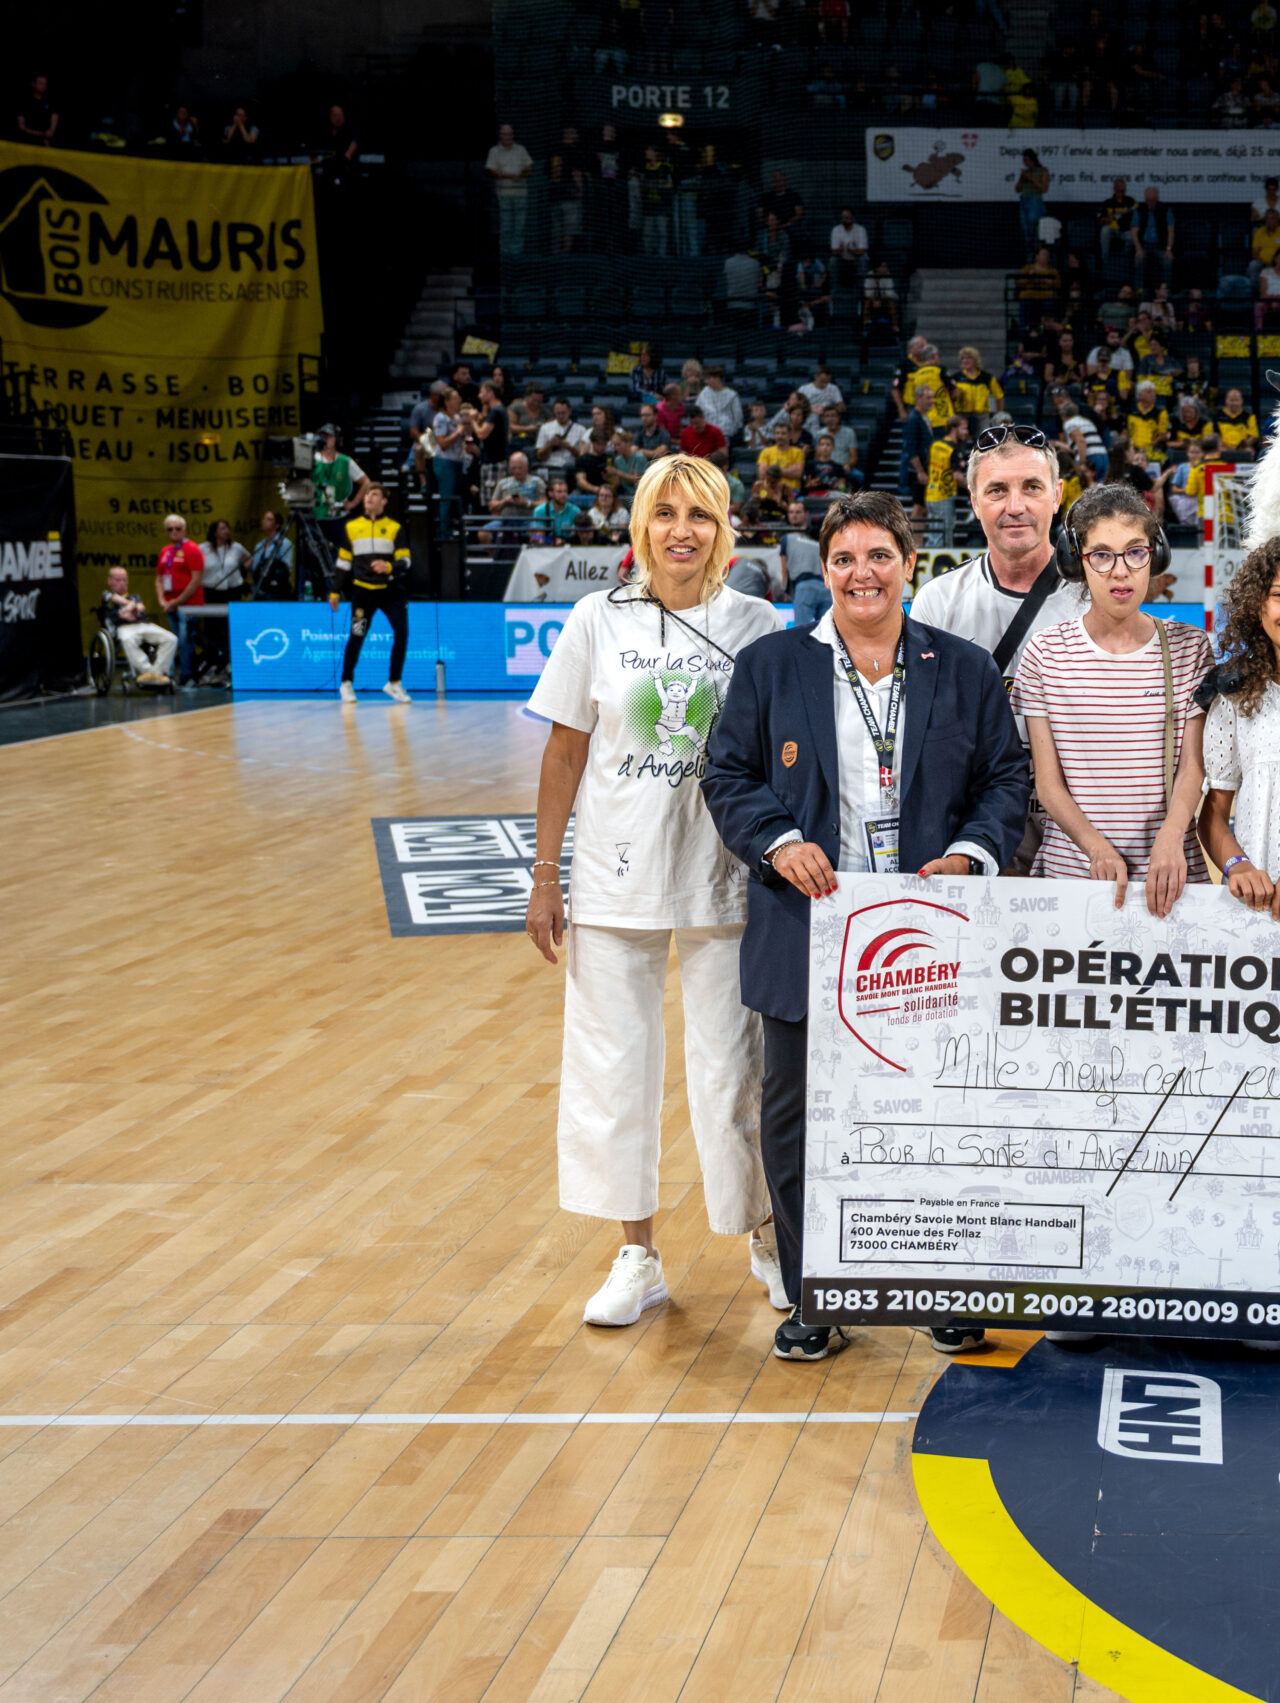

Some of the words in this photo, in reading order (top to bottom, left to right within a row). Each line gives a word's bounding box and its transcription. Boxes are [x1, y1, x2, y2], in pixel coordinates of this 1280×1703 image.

[611, 85, 692, 109] PORTE
[703, 85, 730, 109] 12
[1096, 146, 1109, 157] de
[1112, 146, 1162, 157] rassembler
[1166, 147, 1188, 157] nous
[1251, 147, 1264, 157] 25
[1150, 173, 1188, 185] toujours
[1207, 173, 1246, 183] continue
[46, 207, 83, 295] BOIS
[88, 211, 306, 273] MAURIS
[229, 373, 295, 396] BOIS
[109, 498, 119, 514] 9
[129, 498, 213, 515] AGENCES
[565, 559, 609, 581] Allez
[619, 649, 662, 670] Pour
[665, 651, 684, 671] la
[892, 681, 901, 702] TEAM
[867, 717, 880, 738] TEAM
[899, 874, 944, 894] JAUNE
[946, 885, 966, 899] ET
[934, 902, 970, 918] NOIR
[1009, 896, 1060, 913] SAVOIE
[855, 959, 962, 993] CHAMBÉRY
[855, 991, 879, 1002] SAVOIE
[881, 988, 900, 999] MONT
[901, 986, 923, 997] BLANC
[924, 981, 959, 993] HANDBALL
[903, 990, 959, 1013] solidarité
[887, 1012, 910, 1026] fonds
[912, 1011, 923, 1022] de
[925, 1008, 959, 1021] dotation
[935, 1032, 1020, 1104] Mille
[1046, 1045, 1125, 1125] neuf
[814, 1089, 832, 1104] ET
[873, 1098, 923, 1115] SAVOIE
[1252, 1106, 1271, 1119] ET
[1240, 1123, 1273, 1137] NOIR
[840, 1151, 850, 1165] à
[927, 1130, 946, 1165] la
[957, 1133, 1029, 1168] Santé
[1025, 1168, 1096, 1185] CHAMBÉRY
[919, 1196, 955, 1207] Payable
[957, 1198, 968, 1207] en
[970, 1198, 1000, 1208] France
[850, 1212, 912, 1226] Chambéry
[914, 1213, 954, 1225] Savoie
[956, 1215, 987, 1226] Mont
[989, 1215, 1023, 1227] Blanc
[1025, 1217, 1077, 1229] Handball
[850, 1226, 873, 1237] 400
[875, 1226, 921, 1238] Avenue
[923, 1226, 944, 1238] des
[946, 1227, 982, 1239] Follaz
[850, 1239, 888, 1251] 73000
[890, 1238, 958, 1252] CHAMBÉRY
[988, 1262, 1058, 1280] CHAMBÉRY
[813, 1288, 879, 1312] 1983
[886, 1289, 1015, 1315] 21052001
[1022, 1292, 1095, 1318] 2002
[1101, 1296, 1239, 1324] 28012009
